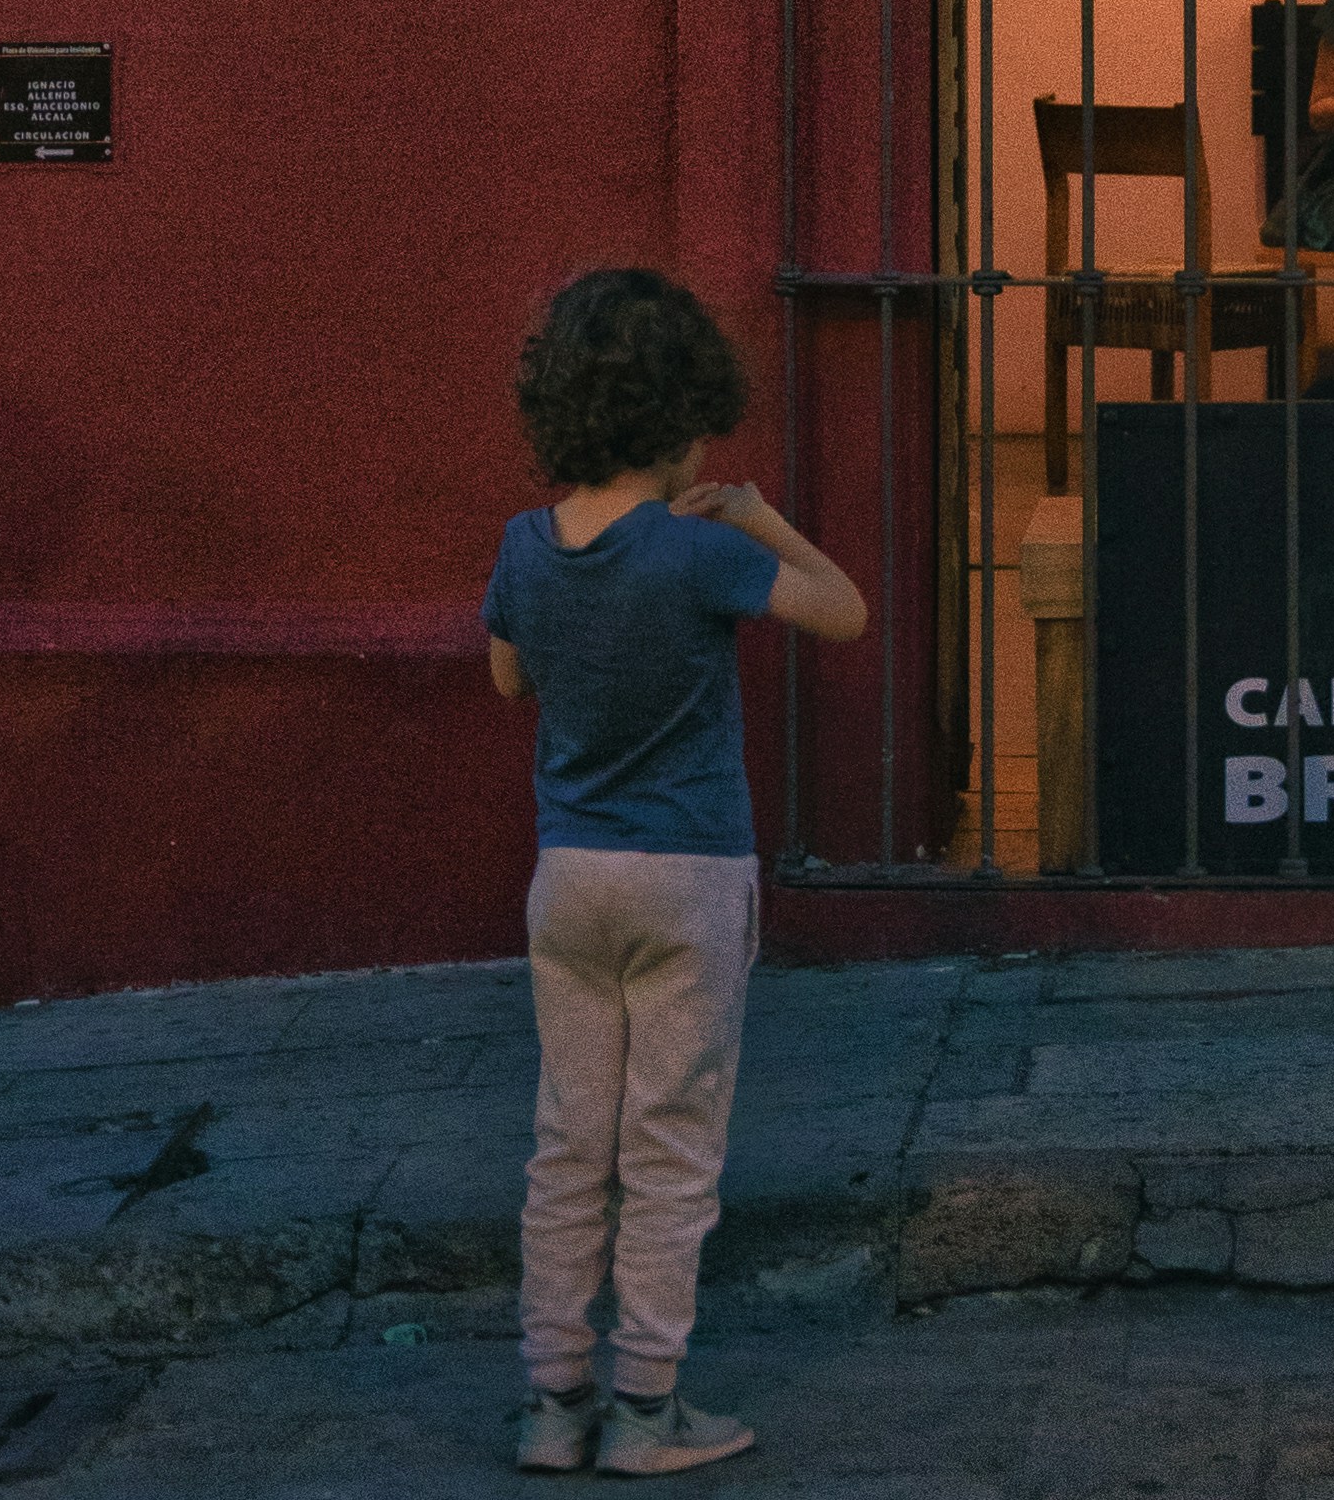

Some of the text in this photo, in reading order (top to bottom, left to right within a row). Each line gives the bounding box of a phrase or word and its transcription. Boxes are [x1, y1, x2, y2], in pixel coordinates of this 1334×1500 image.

[27, 80, 76, 90] IGNACIO
[27, 91, 77, 101] ALLENDE
[3, 102, 101, 111] ESQ. MACEDONIO
